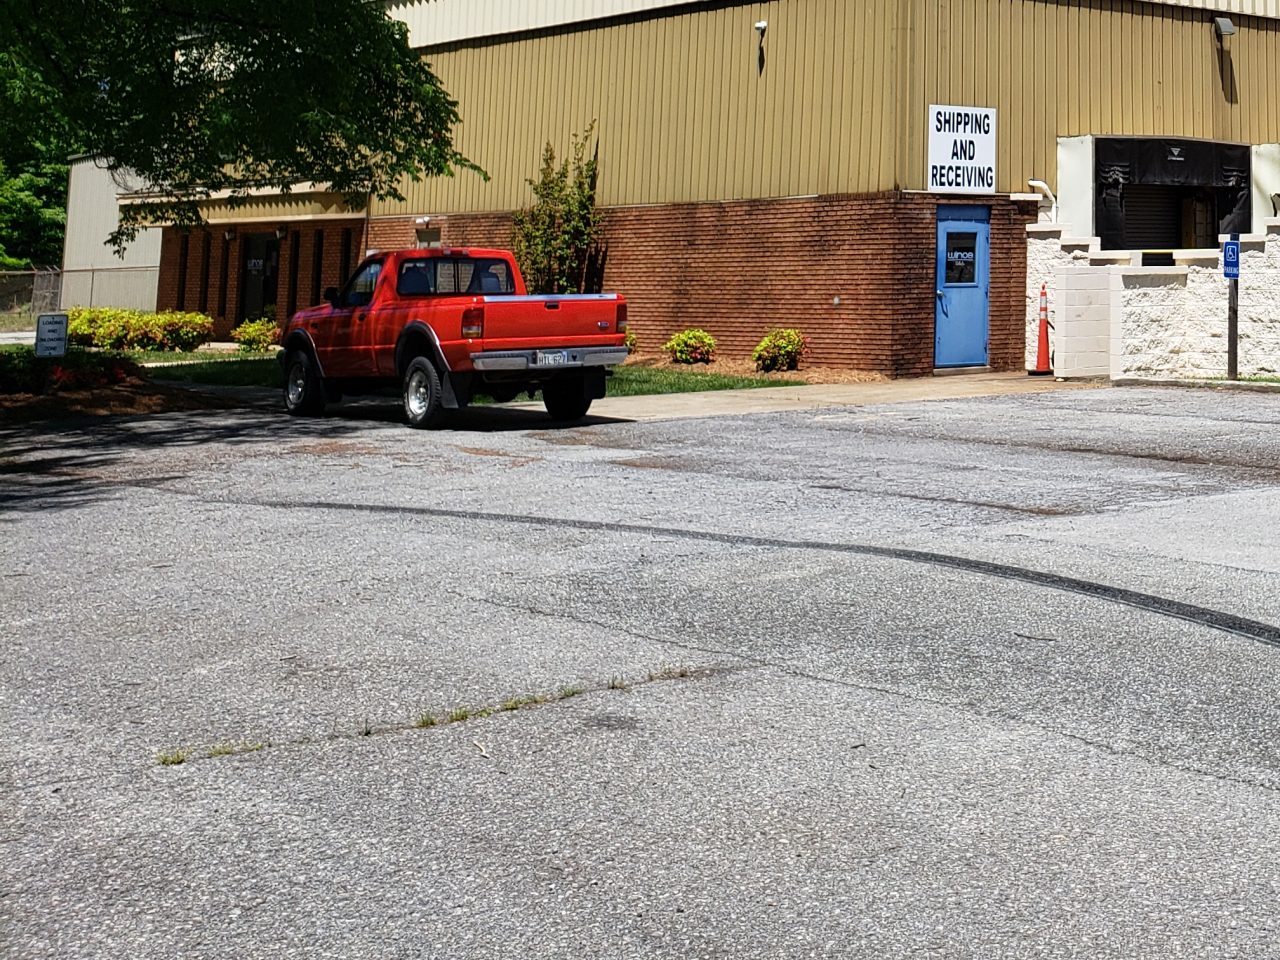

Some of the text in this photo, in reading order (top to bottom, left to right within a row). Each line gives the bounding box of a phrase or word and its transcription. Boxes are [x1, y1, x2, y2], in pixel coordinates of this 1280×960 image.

[935, 111, 990, 134] SHIPPING
[951, 139, 975, 160] AND
[931, 165, 993, 187] RECEIVING
